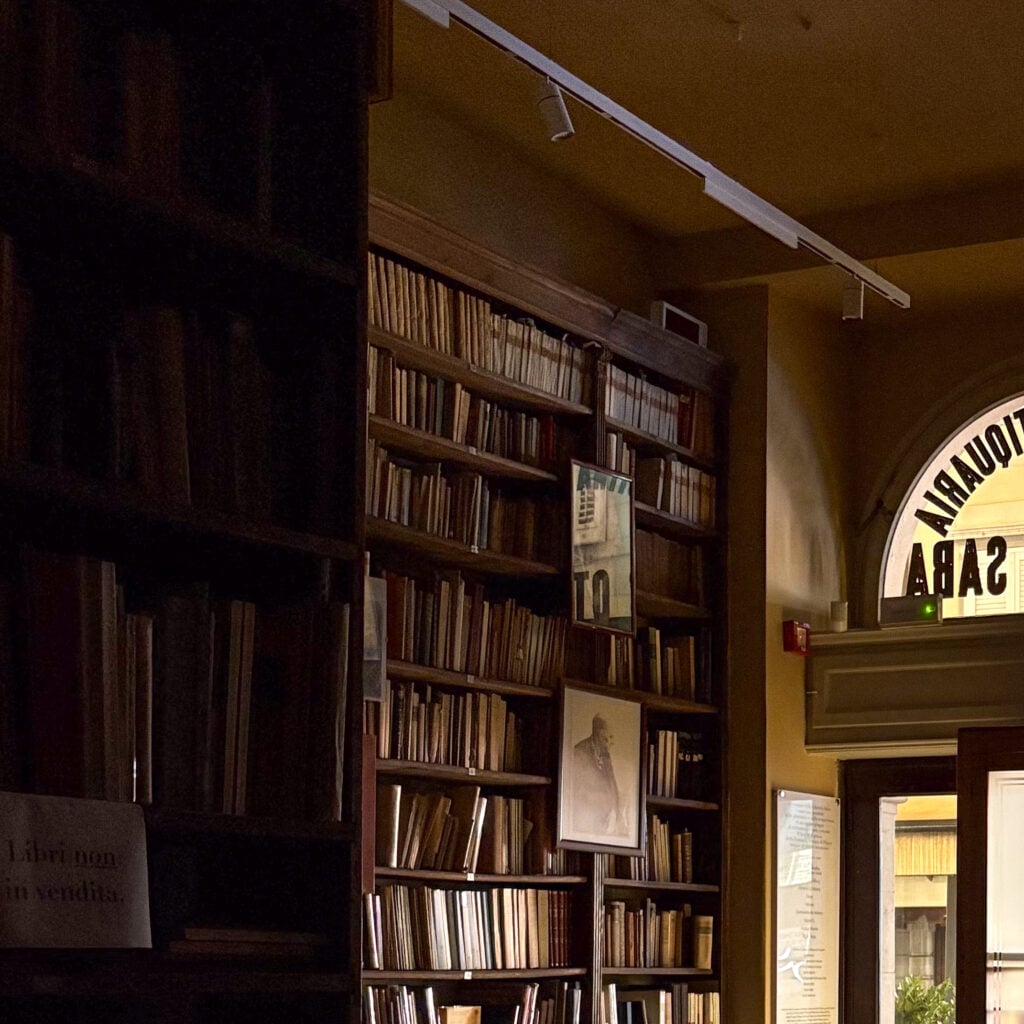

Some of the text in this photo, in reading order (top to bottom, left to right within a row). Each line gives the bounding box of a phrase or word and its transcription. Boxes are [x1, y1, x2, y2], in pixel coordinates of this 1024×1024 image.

[8, 838, 117, 866] Libri non
[6, 877, 28, 900] in
